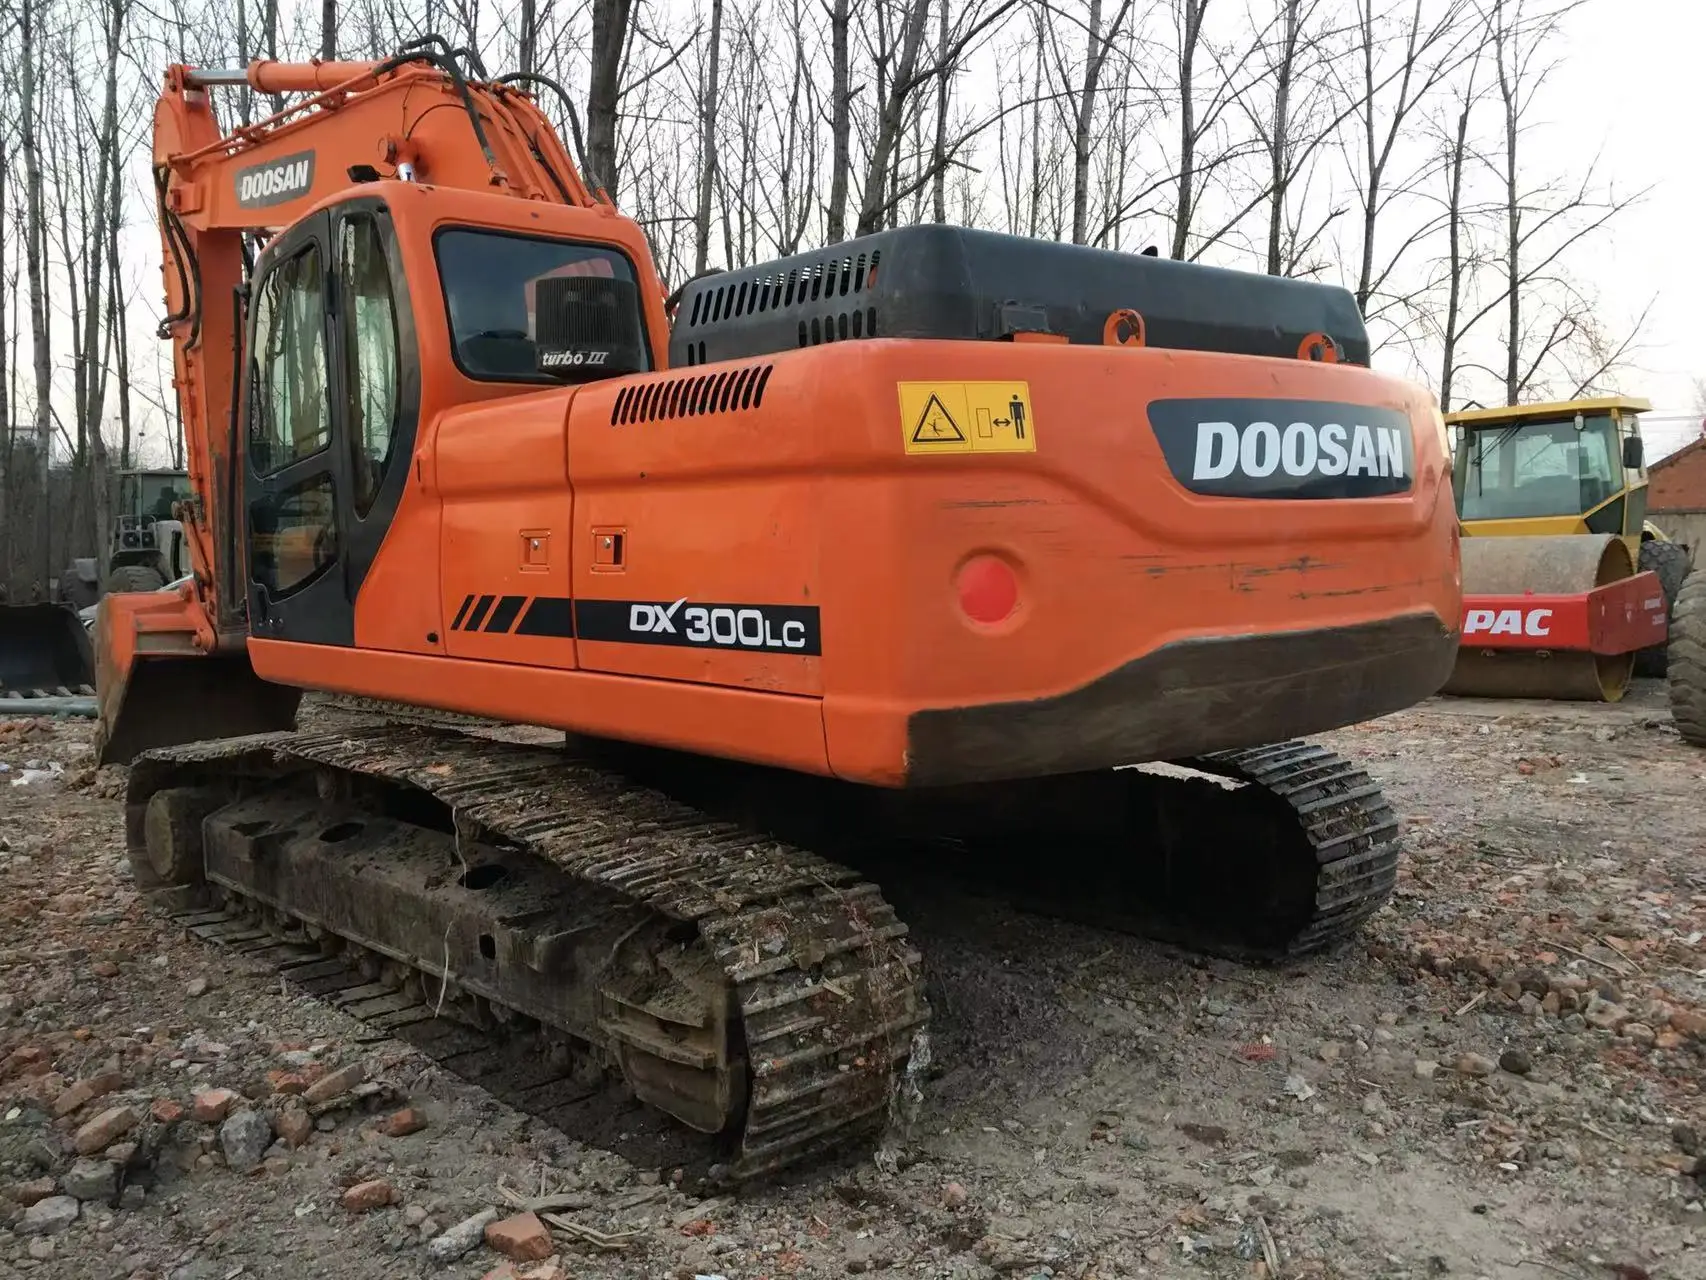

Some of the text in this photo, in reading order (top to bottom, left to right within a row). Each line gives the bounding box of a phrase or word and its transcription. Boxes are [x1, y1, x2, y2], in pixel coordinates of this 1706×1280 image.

[241, 160, 309, 201] DOOSAN
[542, 350, 584, 366] turbo
[1193, 421, 1404, 480] DOOSAN
